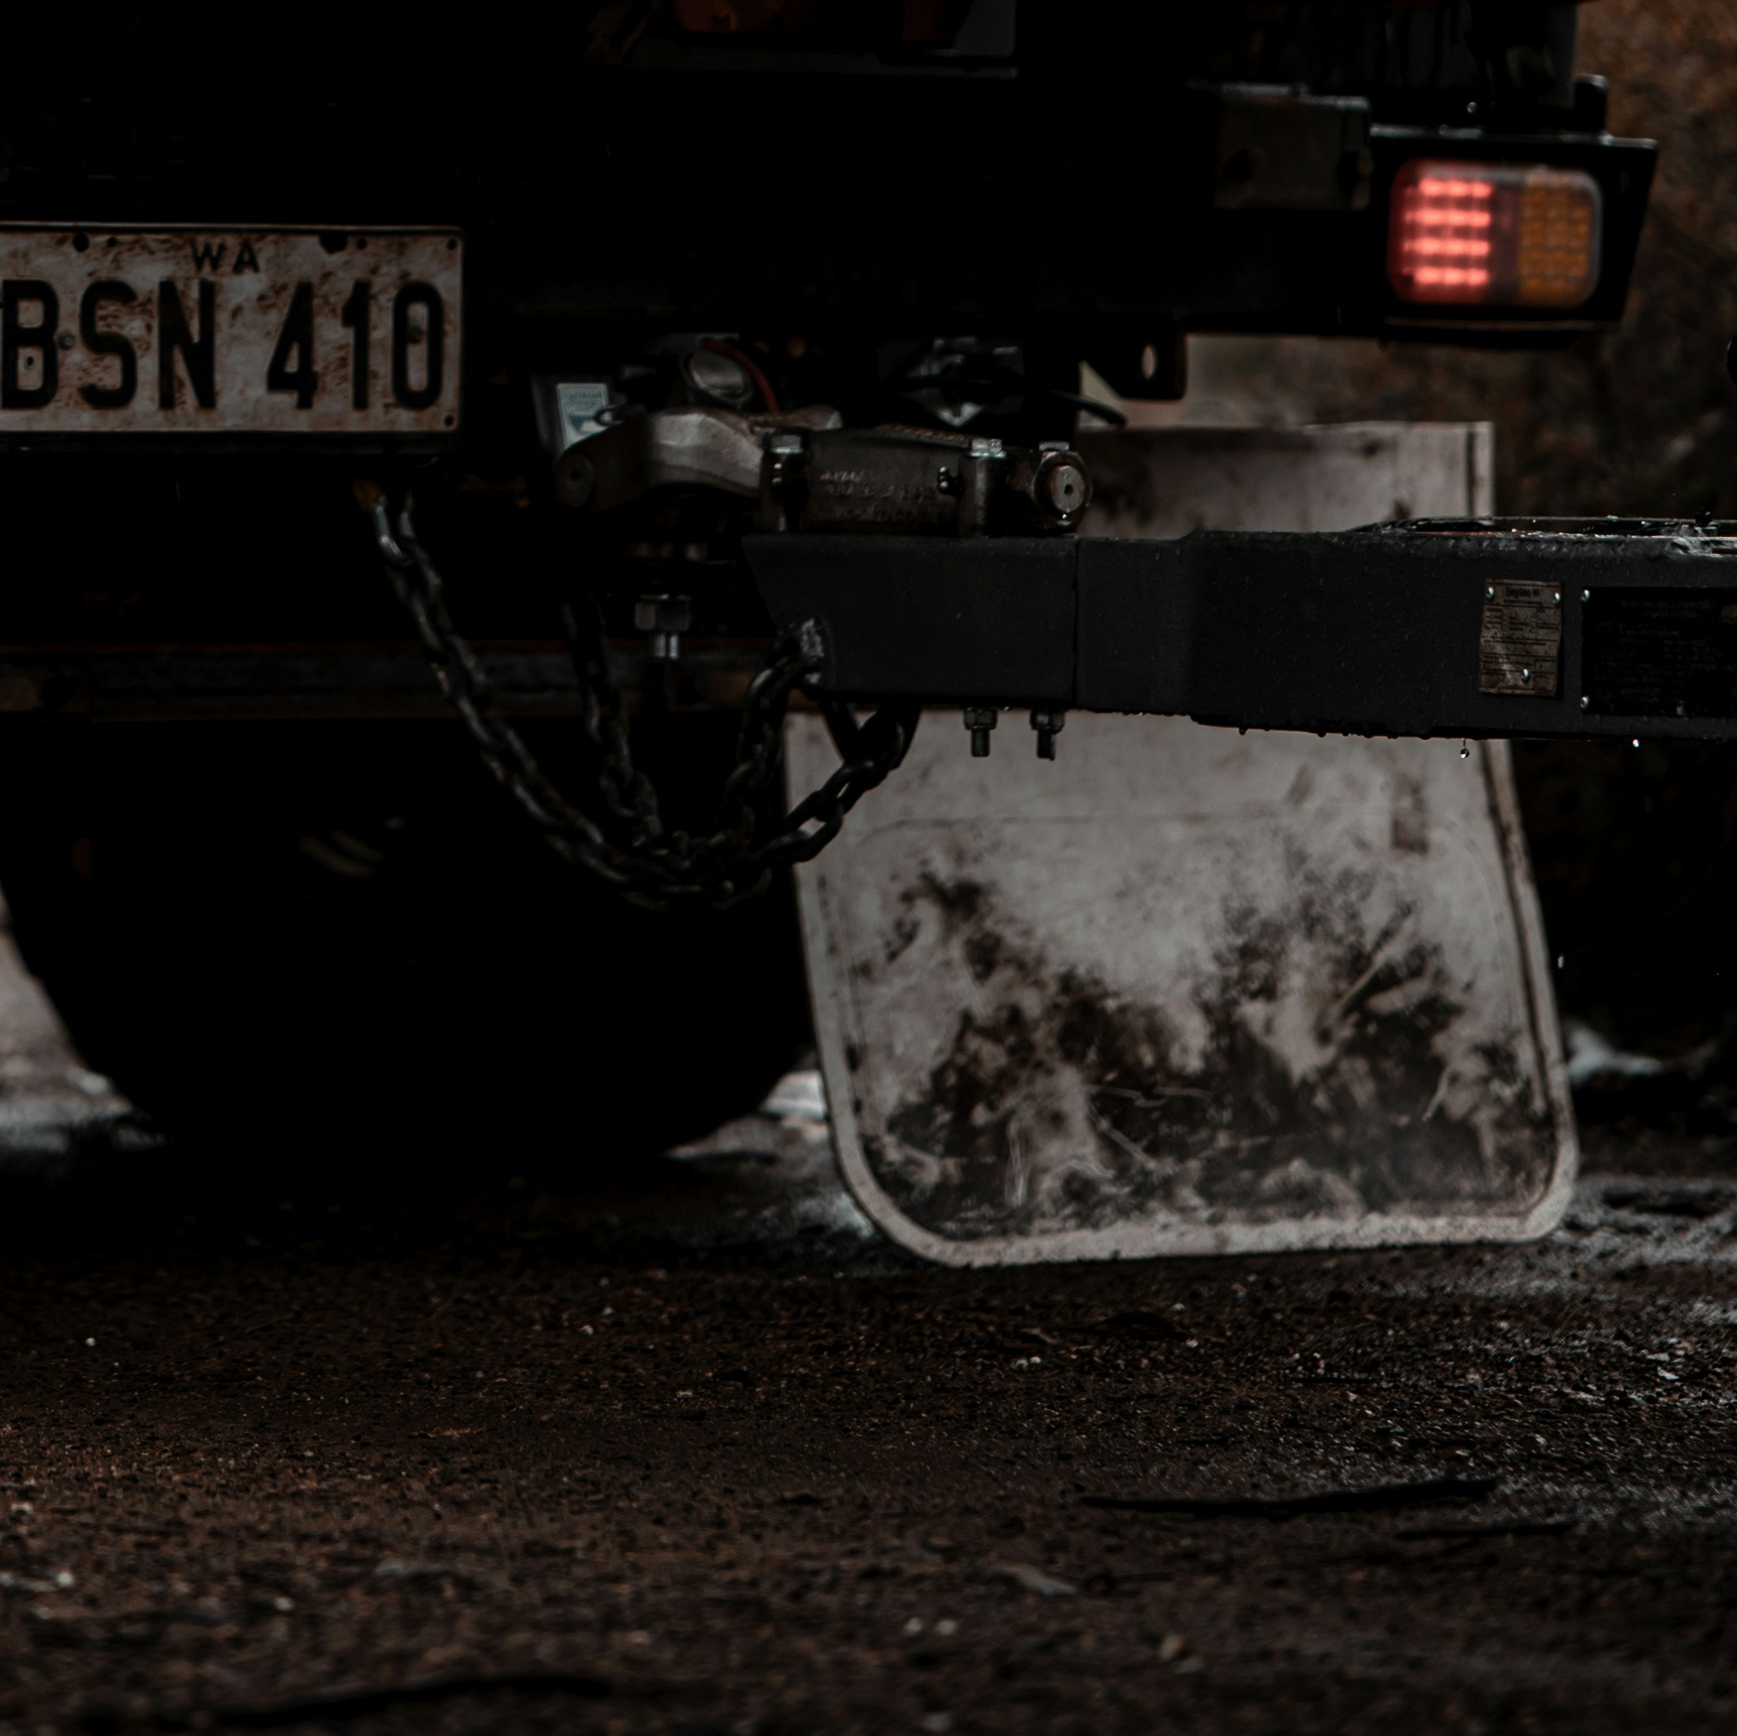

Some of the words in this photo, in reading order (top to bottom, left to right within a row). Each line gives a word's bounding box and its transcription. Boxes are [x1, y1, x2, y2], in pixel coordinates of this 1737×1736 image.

[191, 241, 261, 274] WA
[0, 278, 216, 411] BSN
[266, 280, 445, 411] 410
